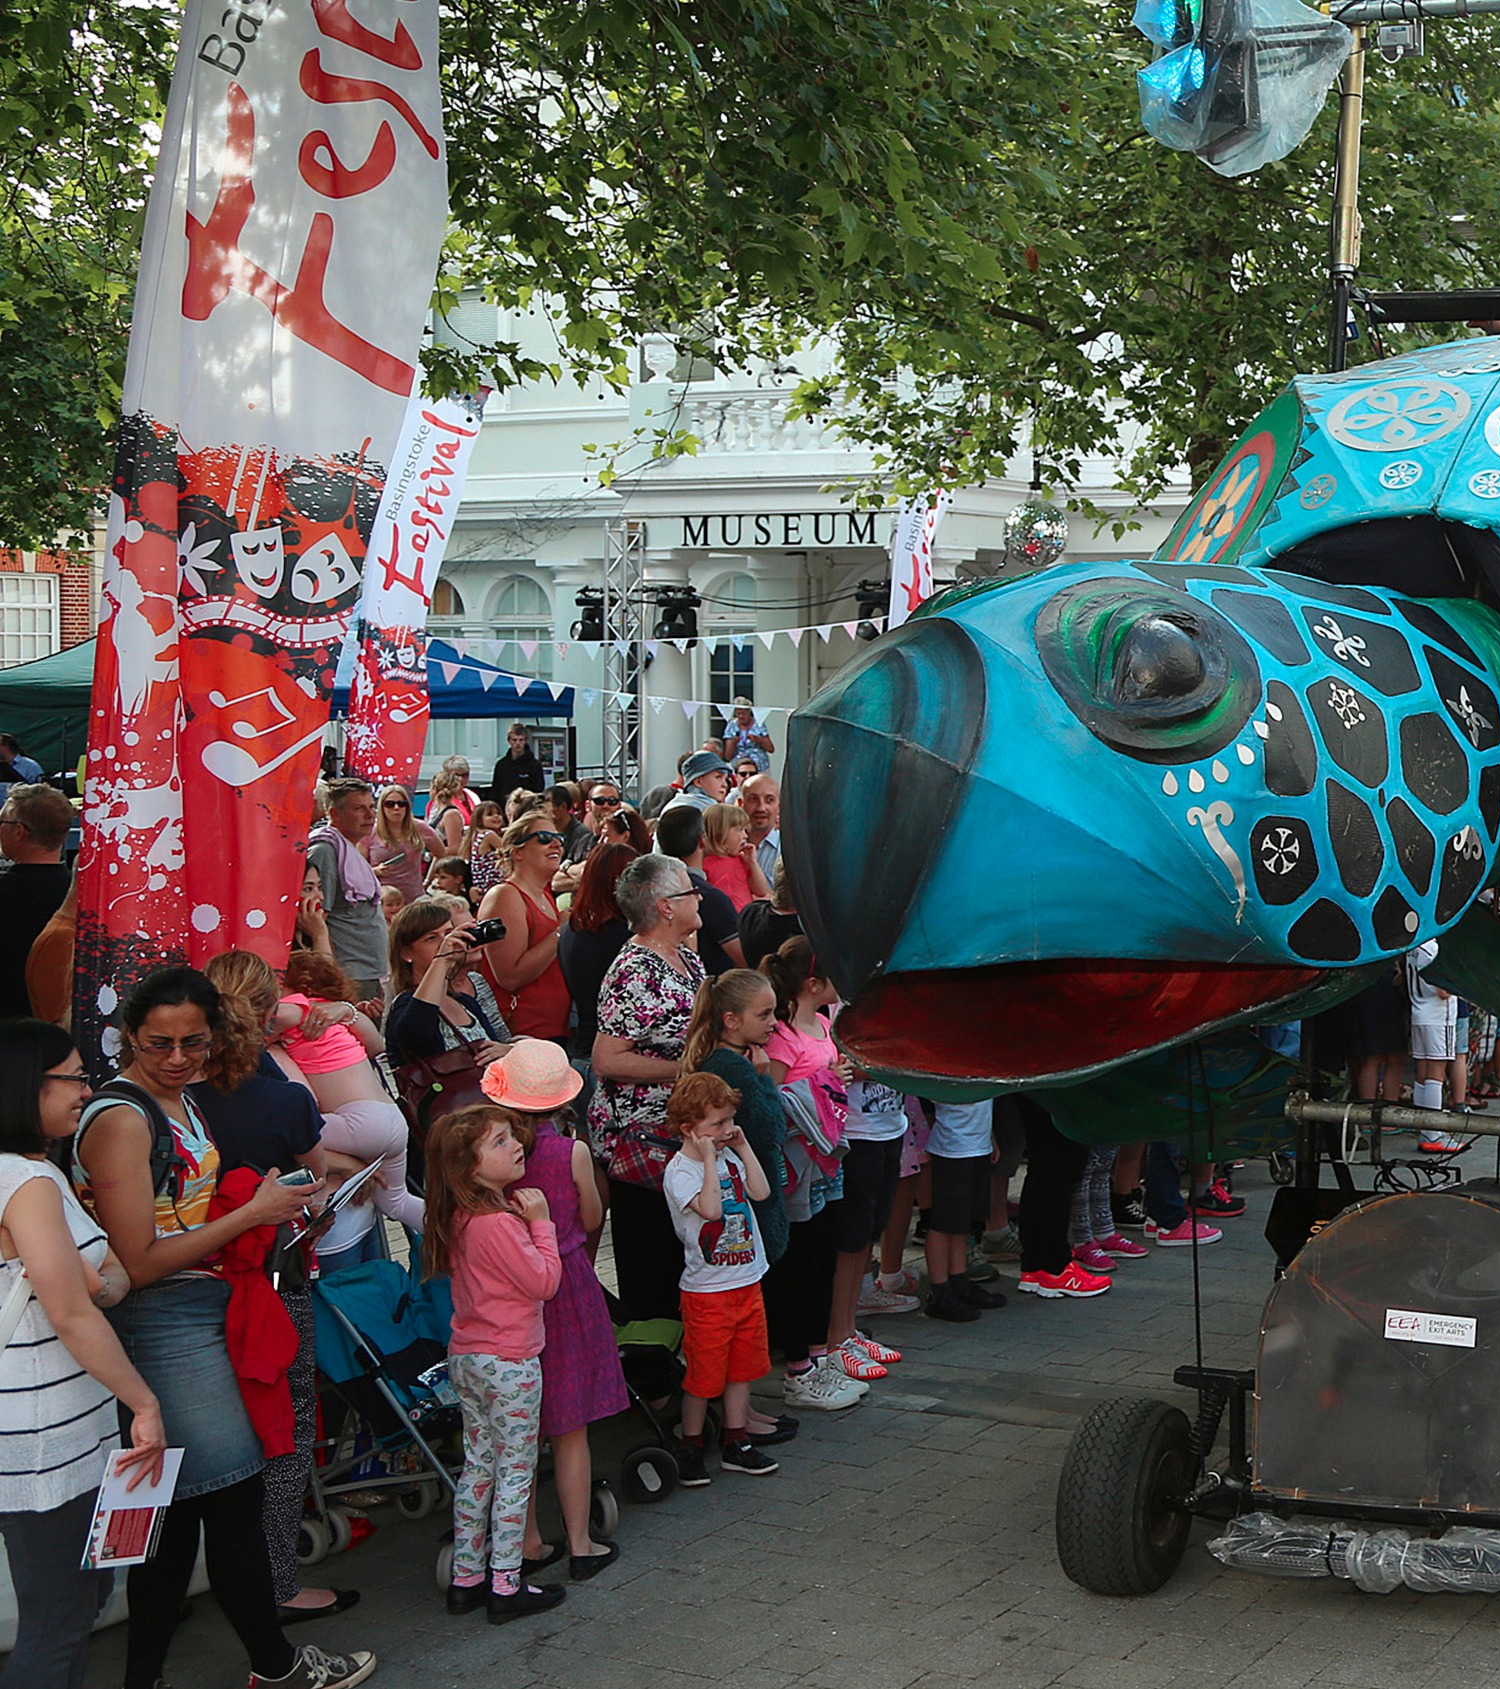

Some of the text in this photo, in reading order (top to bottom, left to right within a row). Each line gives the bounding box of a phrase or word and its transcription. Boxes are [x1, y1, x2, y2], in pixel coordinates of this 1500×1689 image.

[385, 424, 431, 522] Basingstoke
[377, 410, 478, 607] Festival
[681, 512, 878, 547] MUSEUM
[1428, 1320, 1474, 1330] EMERGENCY
